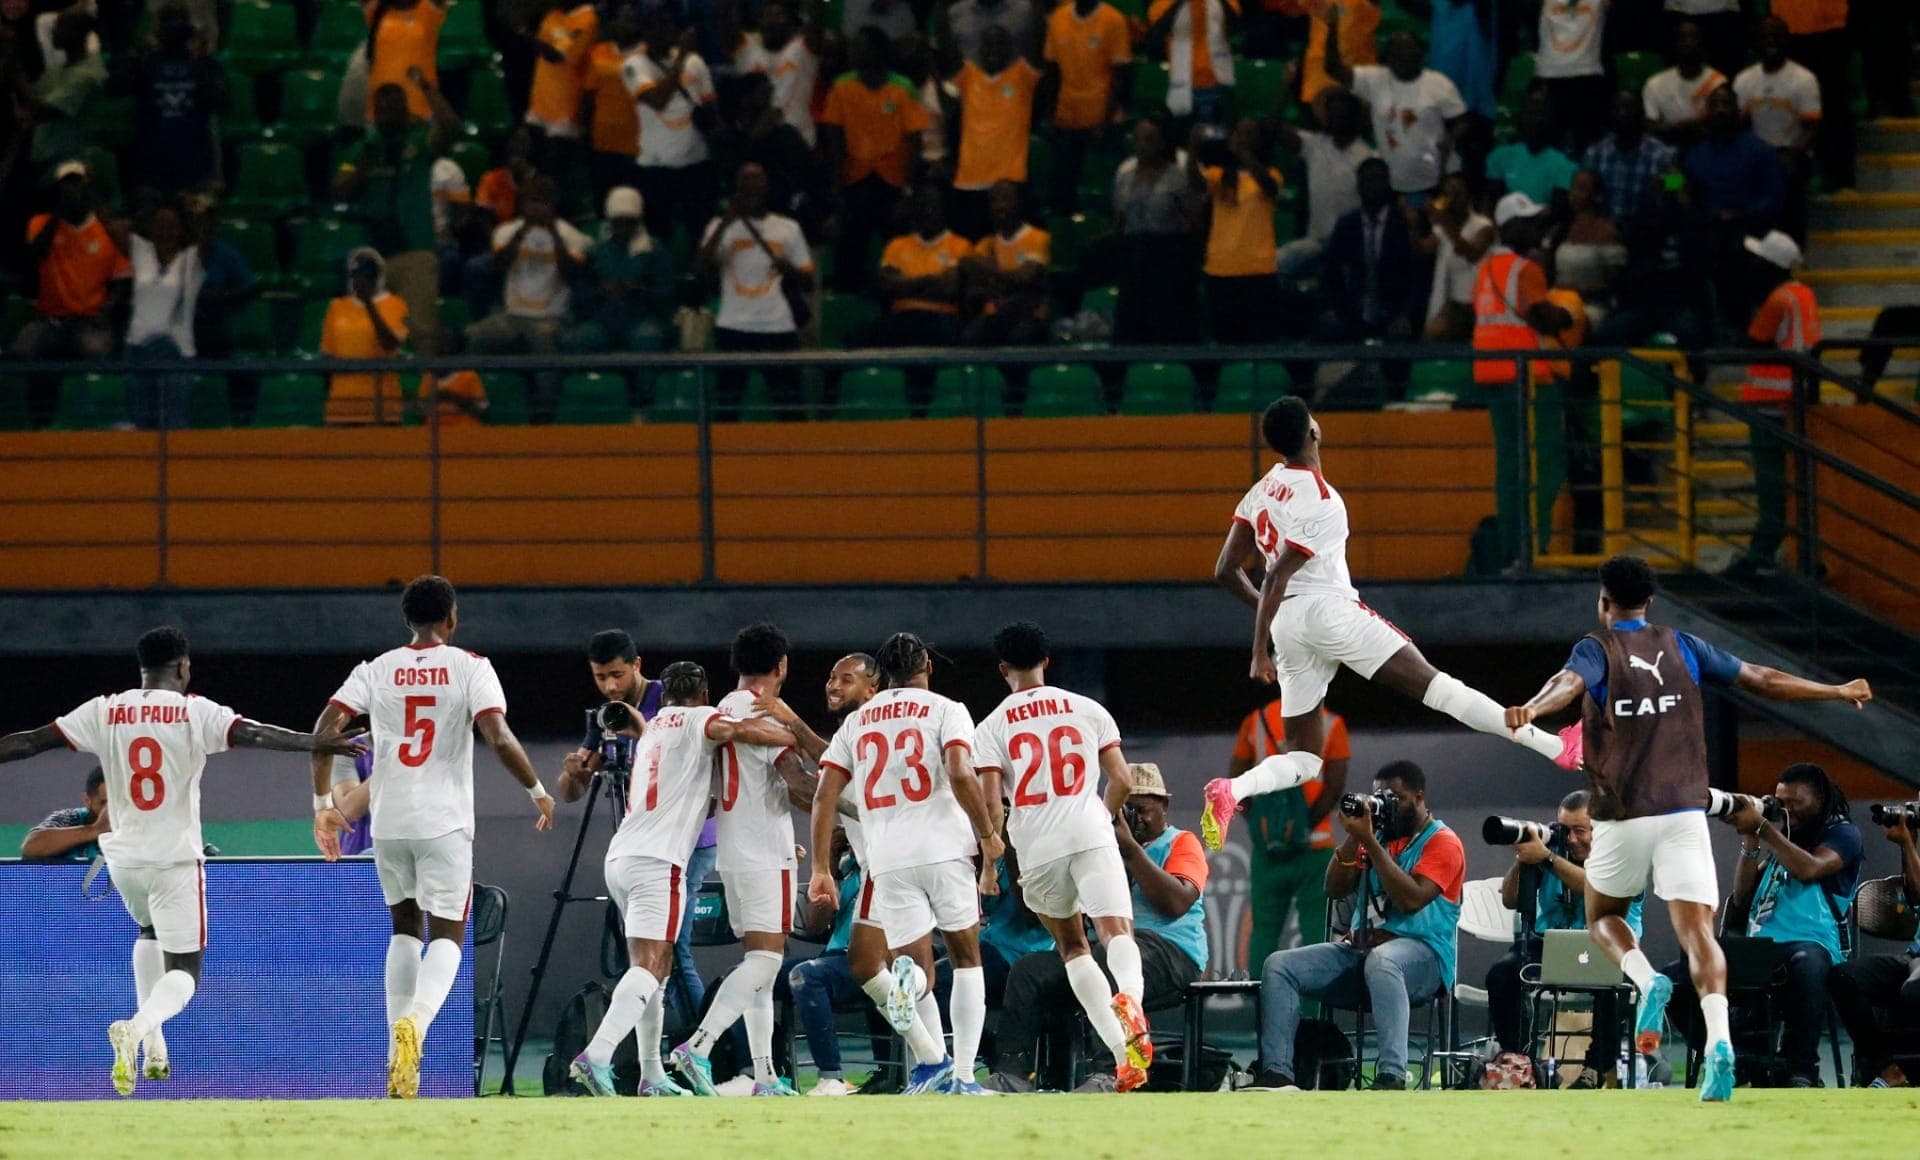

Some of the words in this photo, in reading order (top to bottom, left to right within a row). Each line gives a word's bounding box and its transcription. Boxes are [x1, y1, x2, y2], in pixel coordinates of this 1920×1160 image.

[394, 667, 450, 687] COSTA
[859, 701, 930, 727] MOREIRA
[1006, 698, 1073, 724] KEVIN.L
[1614, 694, 1677, 717] CAF
[398, 695, 437, 768] 5
[128, 736, 166, 812] 8
[856, 728, 932, 811] 23
[1008, 725, 1086, 808] 26
